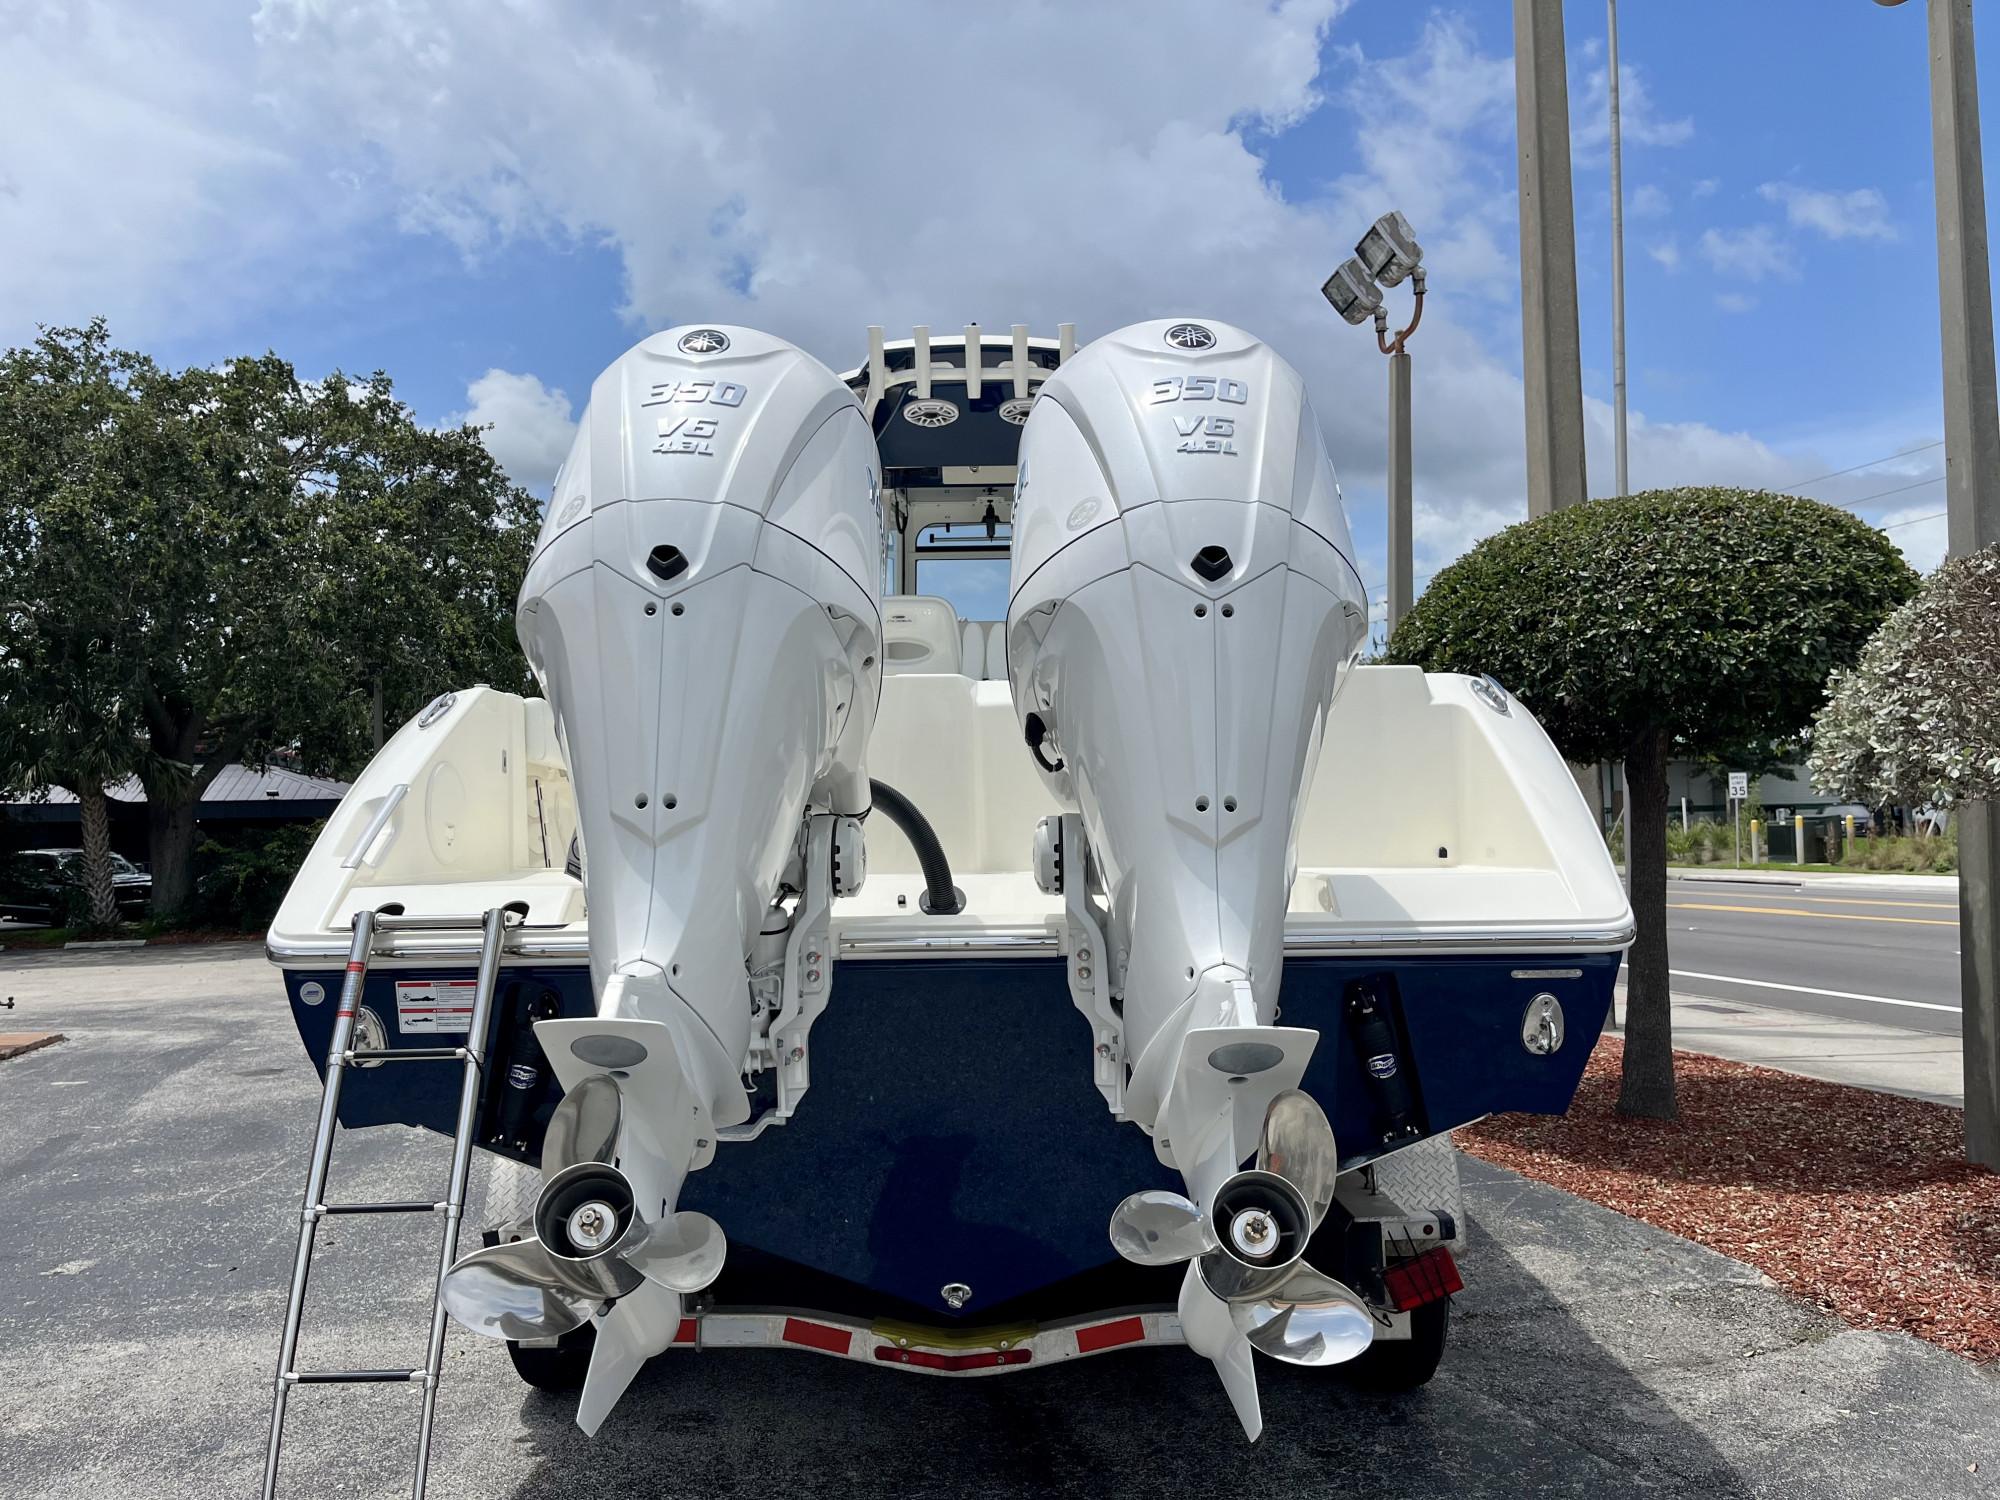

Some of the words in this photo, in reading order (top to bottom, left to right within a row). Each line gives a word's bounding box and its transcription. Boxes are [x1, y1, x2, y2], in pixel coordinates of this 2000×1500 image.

[641, 379, 748, 408] 350
[1150, 375, 1249, 405] 350
[656, 416, 719, 439] V6
[1173, 415, 1235, 438] V6
[1731, 786, 1745, 796] 35
